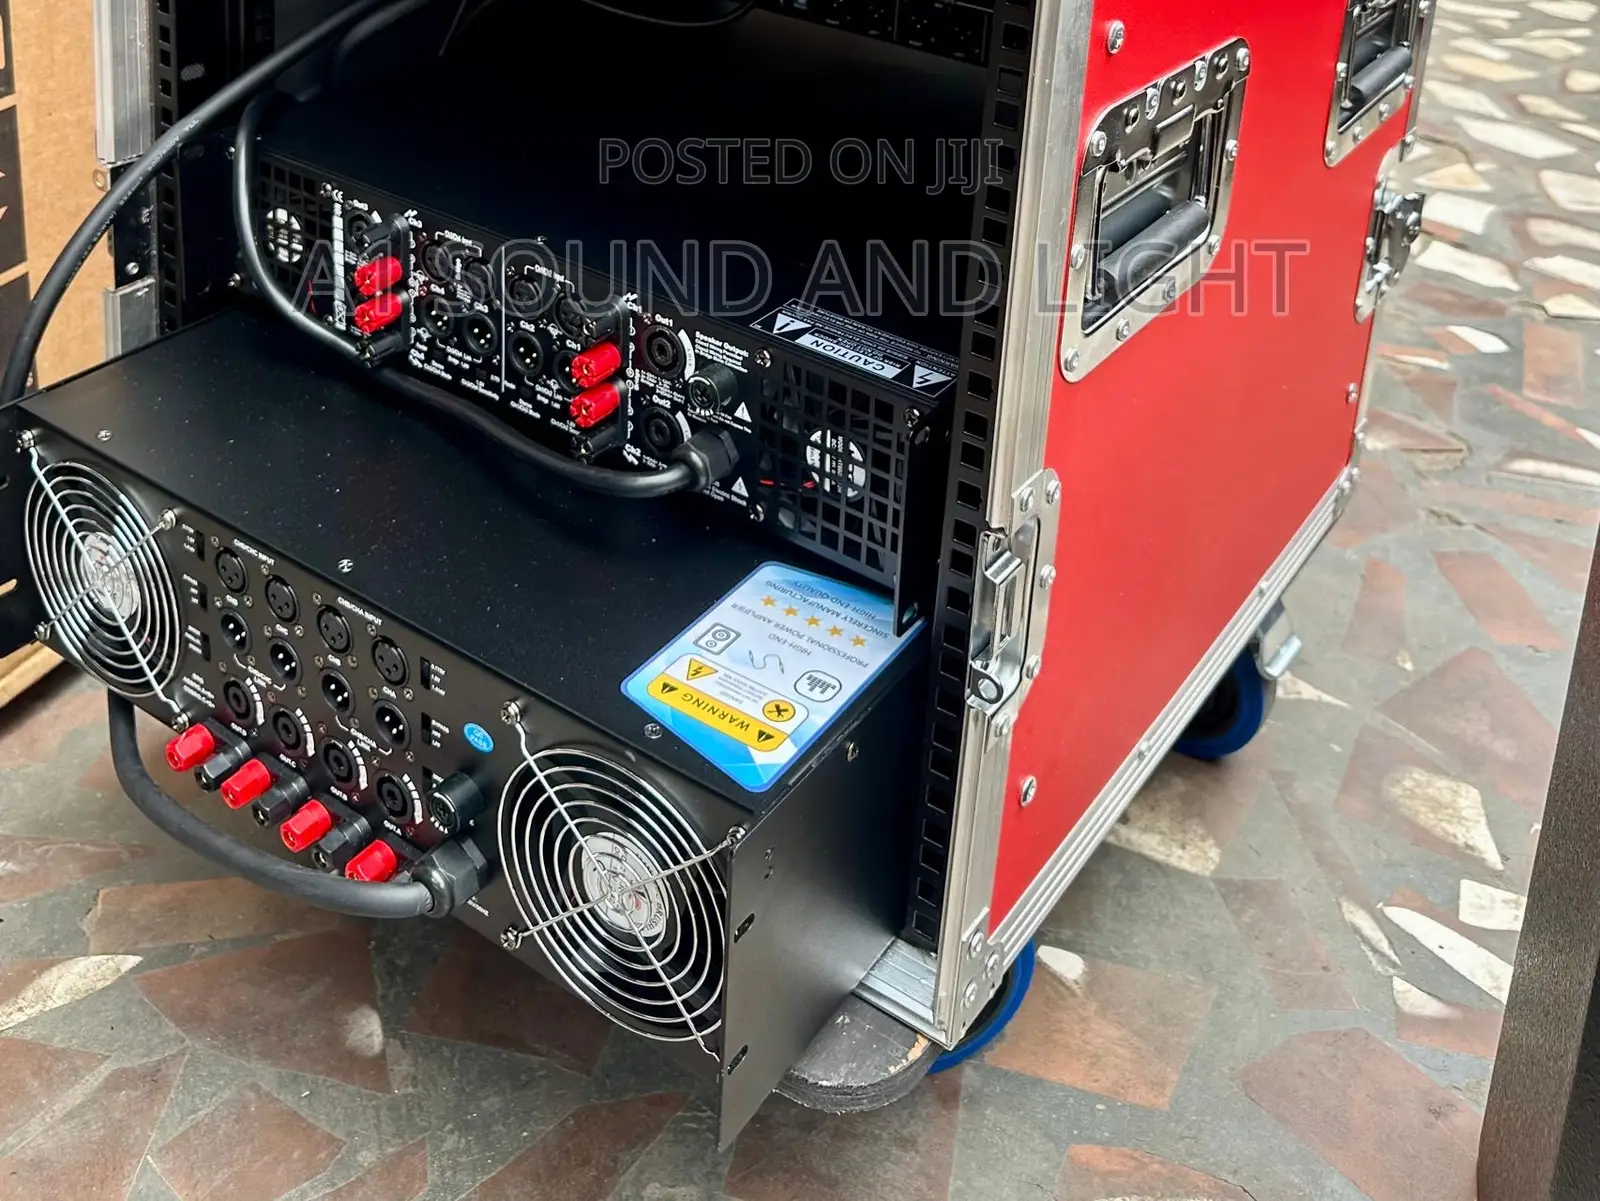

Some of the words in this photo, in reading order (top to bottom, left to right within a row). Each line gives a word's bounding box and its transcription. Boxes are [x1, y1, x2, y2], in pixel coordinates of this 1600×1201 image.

[626, 301, 643, 314] Ch1
[654, 313, 674, 328] Out1
[565, 339, 582, 352] Ch1
[810, 339, 886, 372] CAUTION
[915, 360, 957, 377] ATTENTION
[652, 394, 671, 409] Out2
[624, 443, 641, 457] Ch2
[765, 580, 843, 619] MANUFACTURING
[830, 595, 877, 621] HIGH-END
[730, 602, 773, 624] AMPLIFIER
[773, 621, 804, 640] POWER
[841, 615, 890, 639] SINCERELY
[767, 632, 813, 657] HIGH-END
[806, 636, 869, 668] PROFESSIONAL
[382, 685, 397, 699] CHA
[681, 692, 751, 732] WARNING
